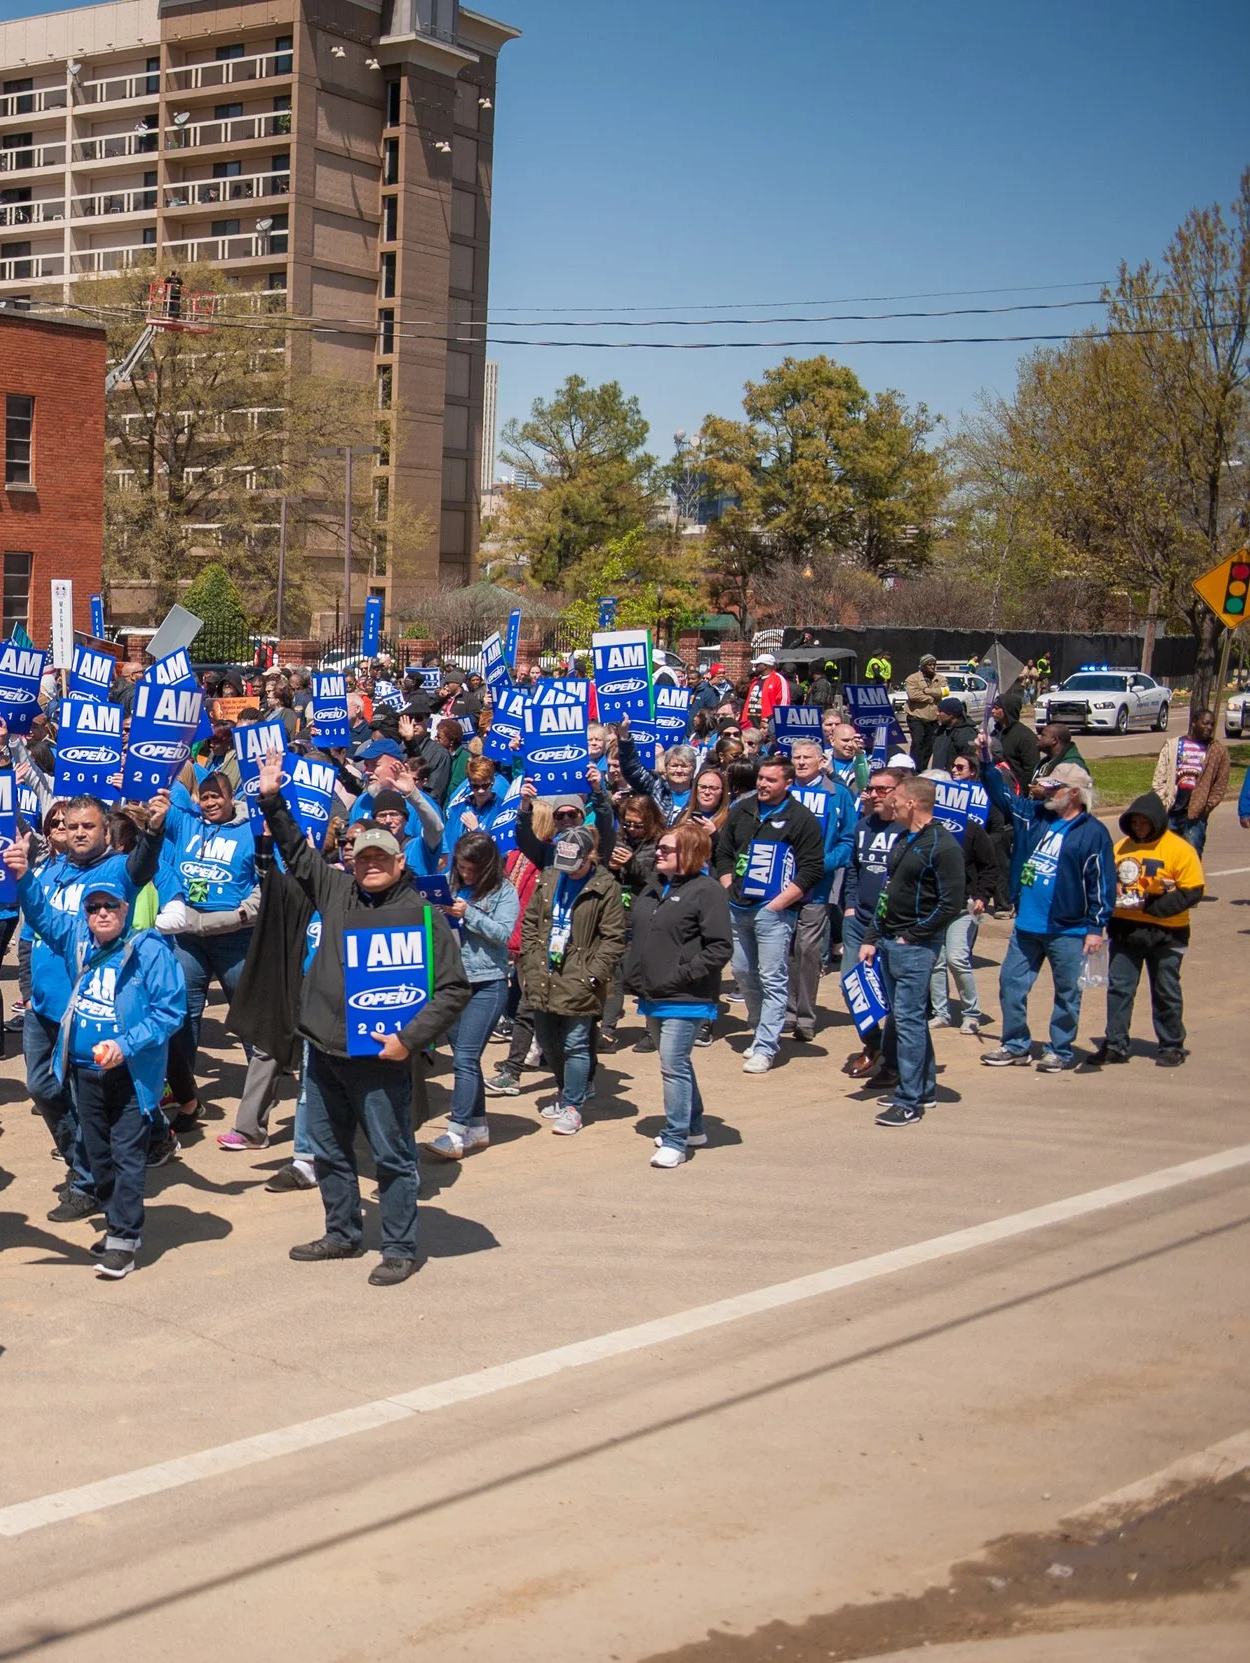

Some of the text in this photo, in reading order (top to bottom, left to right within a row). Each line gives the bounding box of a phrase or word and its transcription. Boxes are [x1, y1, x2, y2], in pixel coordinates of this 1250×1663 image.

[488, 640, 501, 663] AM
[595, 645, 645, 669] I AM
[72, 649, 112, 683] I AM
[157, 651, 189, 685] AM
[313, 677, 345, 697] I AM
[533, 685, 544, 704] I
[604, 681, 640, 693] OPEIU
[846, 687, 888, 704] I AM
[136, 686, 149, 717] I
[154, 689, 202, 723] AM
[498, 691, 532, 716] I A
[604, 700, 644, 711] 2018
[657, 688, 689, 708] AM
[62, 702, 120, 733] I AM
[458, 717, 473, 732] M
[524, 706, 583, 732] I AM
[656, 719, 680, 728] PEIU
[775, 708, 781, 723] I
[787, 709, 818, 724] AM
[496, 726, 520, 736] OPE
[631, 733, 650, 742] PEIU
[656, 733, 679, 742] 018
[235, 724, 284, 760] I AM
[491, 741, 506, 750] 20
[67, 750, 112, 761] OPEIU
[139, 745, 188, 759] OPEIU
[534, 750, 579, 761] OPEIU
[63, 772, 112, 784] 2018
[133, 771, 172, 785] 201
[293, 760, 334, 793] AM
[534, 771, 582, 782] 2018
[18, 788, 38, 814] M
[935, 784, 970, 810] AM
[299, 801, 324, 818] PEIU
[493, 812, 514, 827] PEIU
[859, 831, 865, 848] I
[186, 835, 238, 863] I AM
[859, 853, 886, 861] 201
[184, 864, 225, 880] OPEIU
[744, 844, 774, 896] I AM
[420, 890, 442, 898] 20
[347, 932, 422, 967] I AM
[865, 968, 885, 1004] OPEIU
[358, 991, 416, 1006] OPEIU
[844, 971, 874, 1031] I AM
[80, 1019, 119, 1033] 018
[358, 1021, 402, 1034] 201
